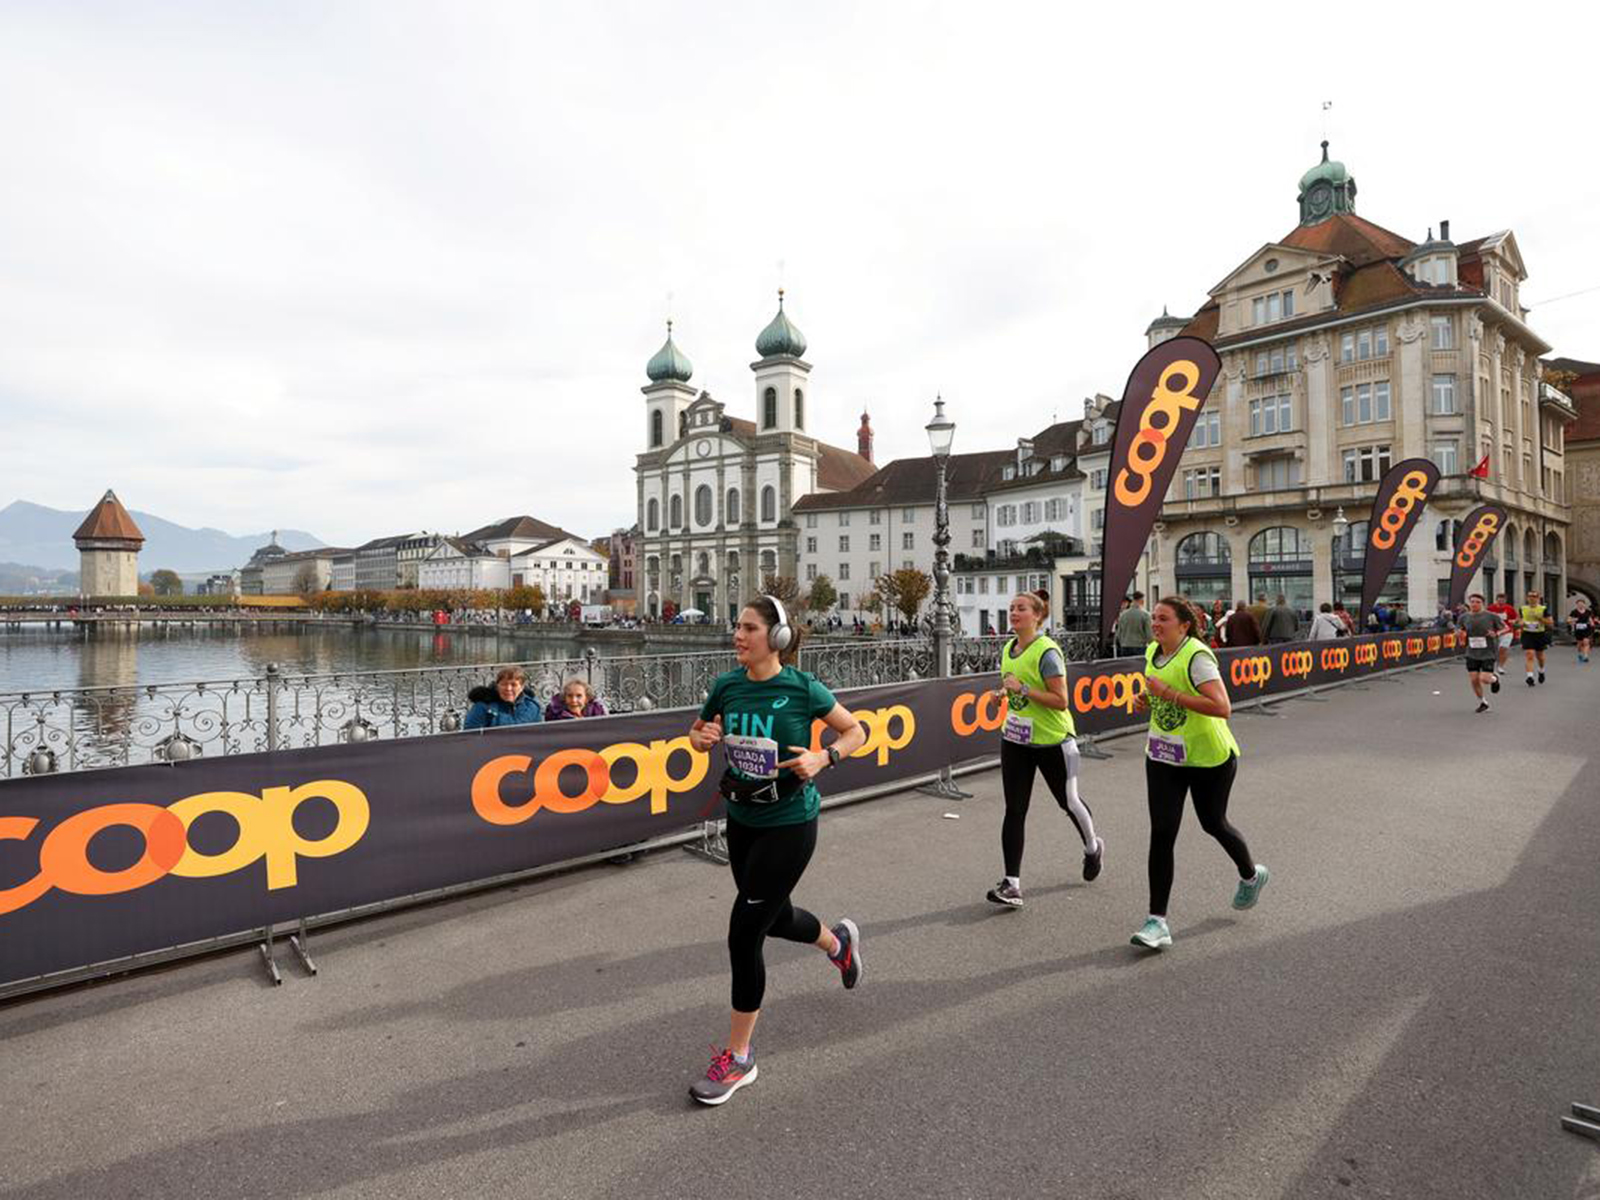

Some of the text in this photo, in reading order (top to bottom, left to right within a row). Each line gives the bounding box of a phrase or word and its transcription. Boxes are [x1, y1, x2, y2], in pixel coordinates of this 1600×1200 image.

[1115, 359, 1200, 506] coop
[1372, 470, 1428, 550] coop
[1457, 512, 1498, 568] coop
[1281, 650, 1314, 680] coop
[1321, 647, 1350, 673] coop
[1355, 643, 1378, 667] coop
[1382, 640, 1403, 661] coop
[1406, 638, 1424, 658] coop
[1073, 671, 1147, 715] coop
[1231, 656, 1272, 689] coop
[809, 704, 915, 766] op
[951, 690, 1009, 736] co
[471, 735, 710, 826] coop
